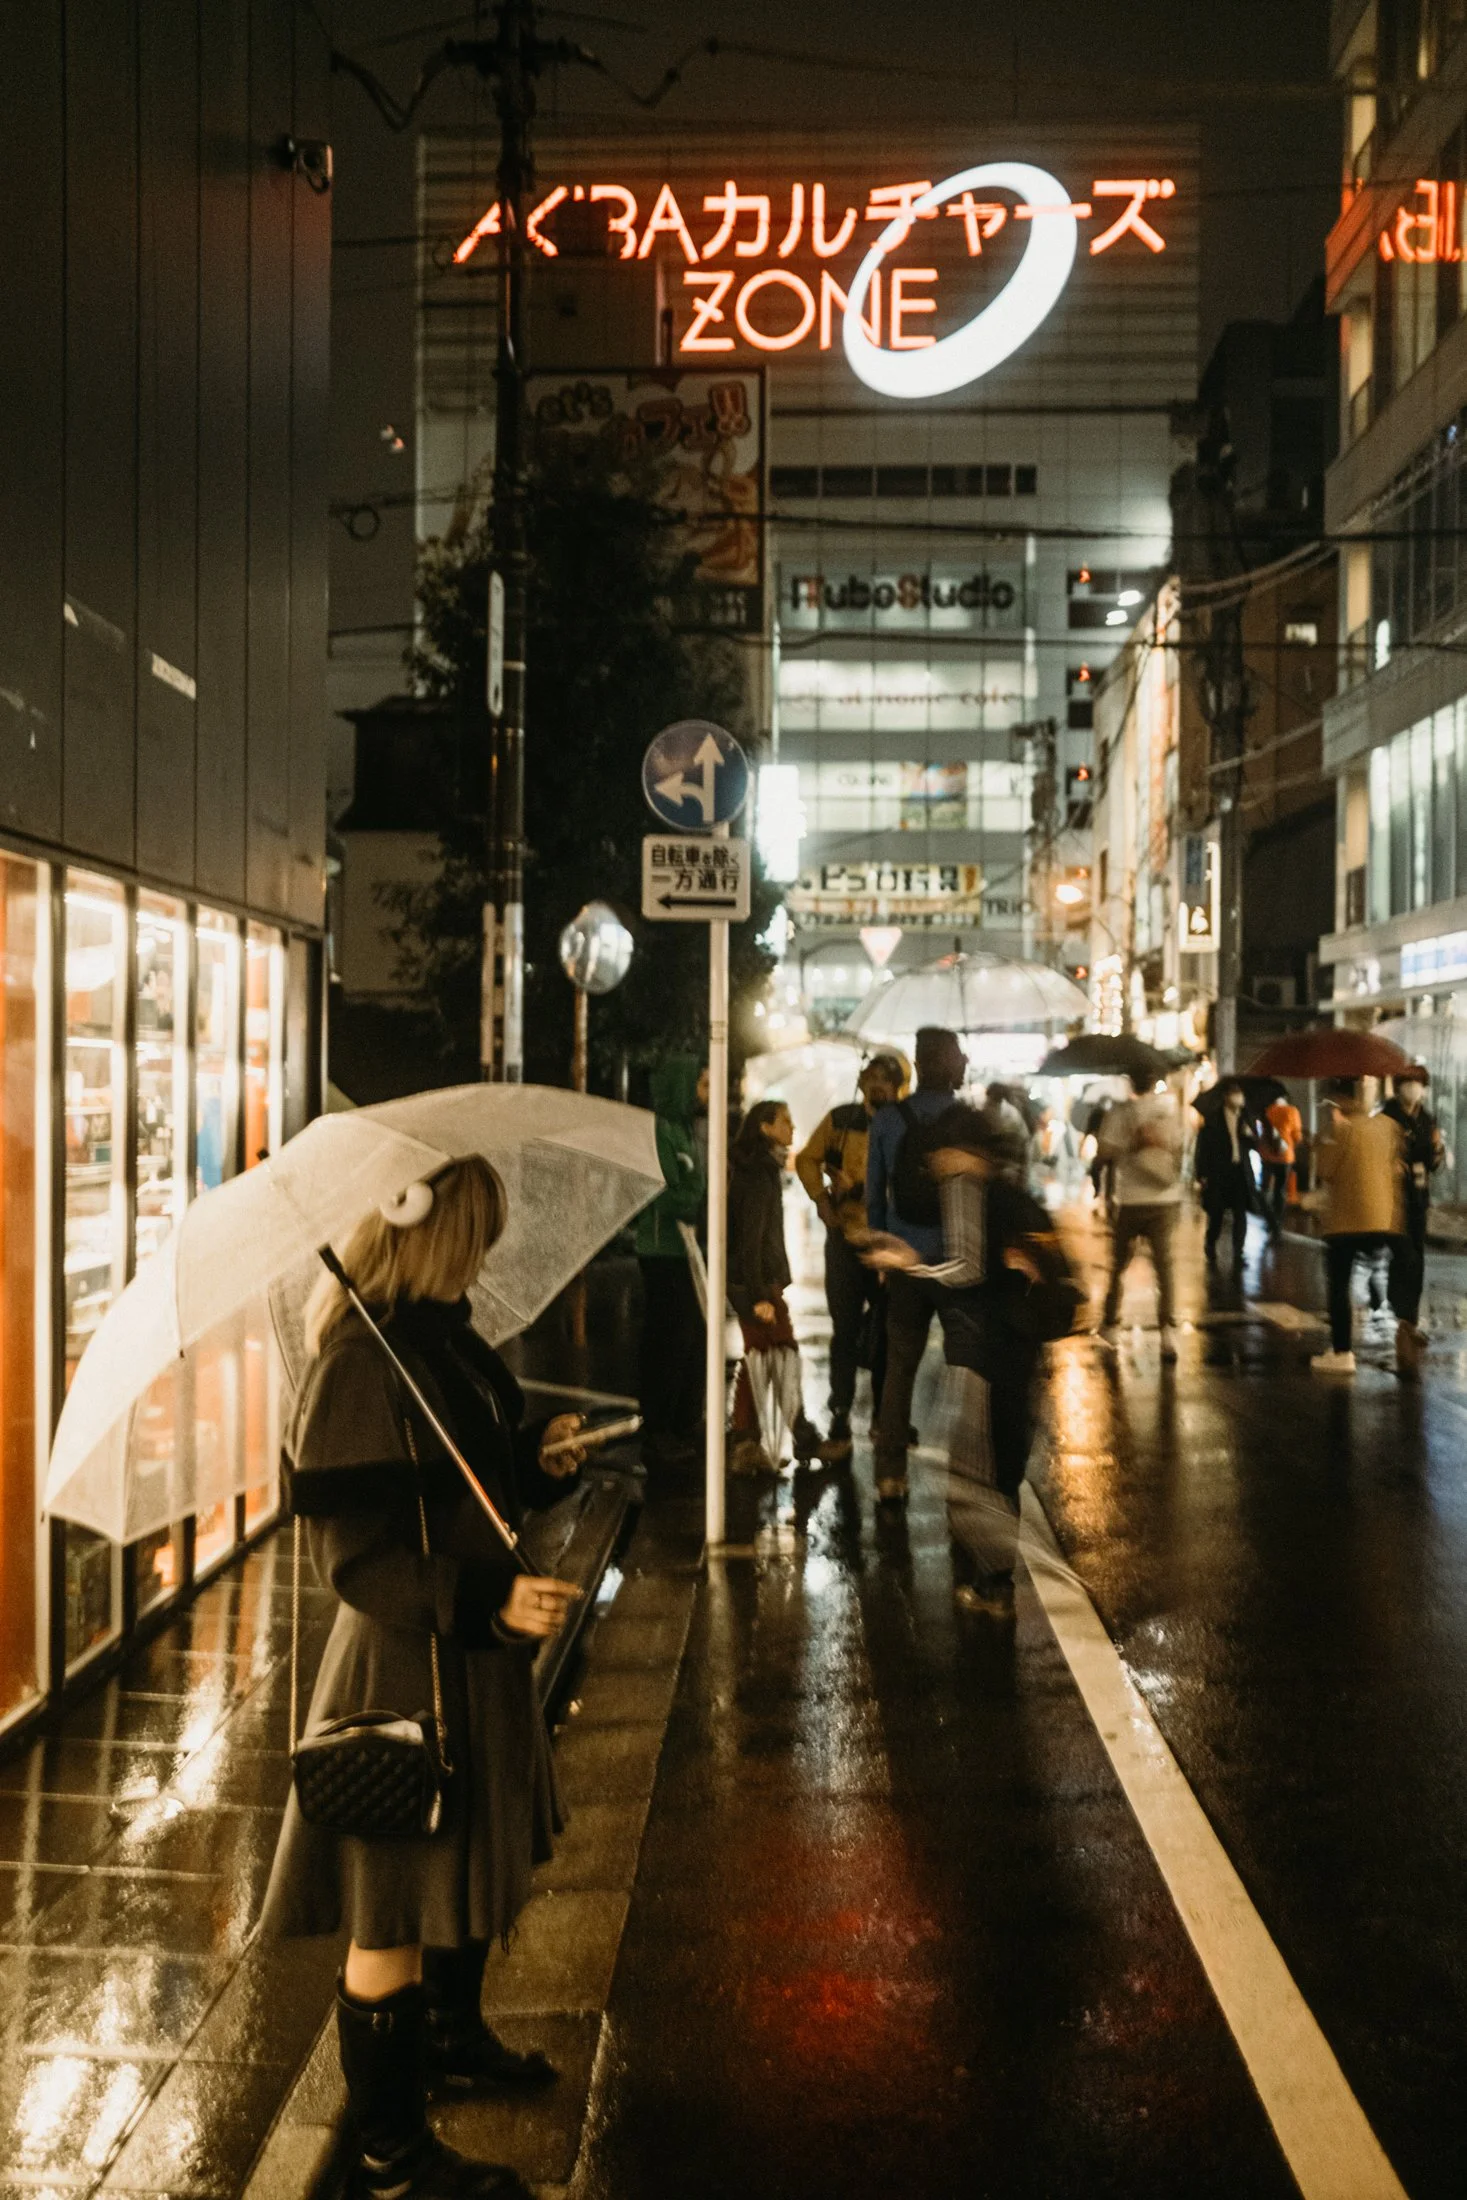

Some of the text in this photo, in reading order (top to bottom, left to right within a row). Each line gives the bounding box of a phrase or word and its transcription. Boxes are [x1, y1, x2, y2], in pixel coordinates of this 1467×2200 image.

[680, 268, 939, 352] ZONE
[652, 867, 740, 892] 一方通行
